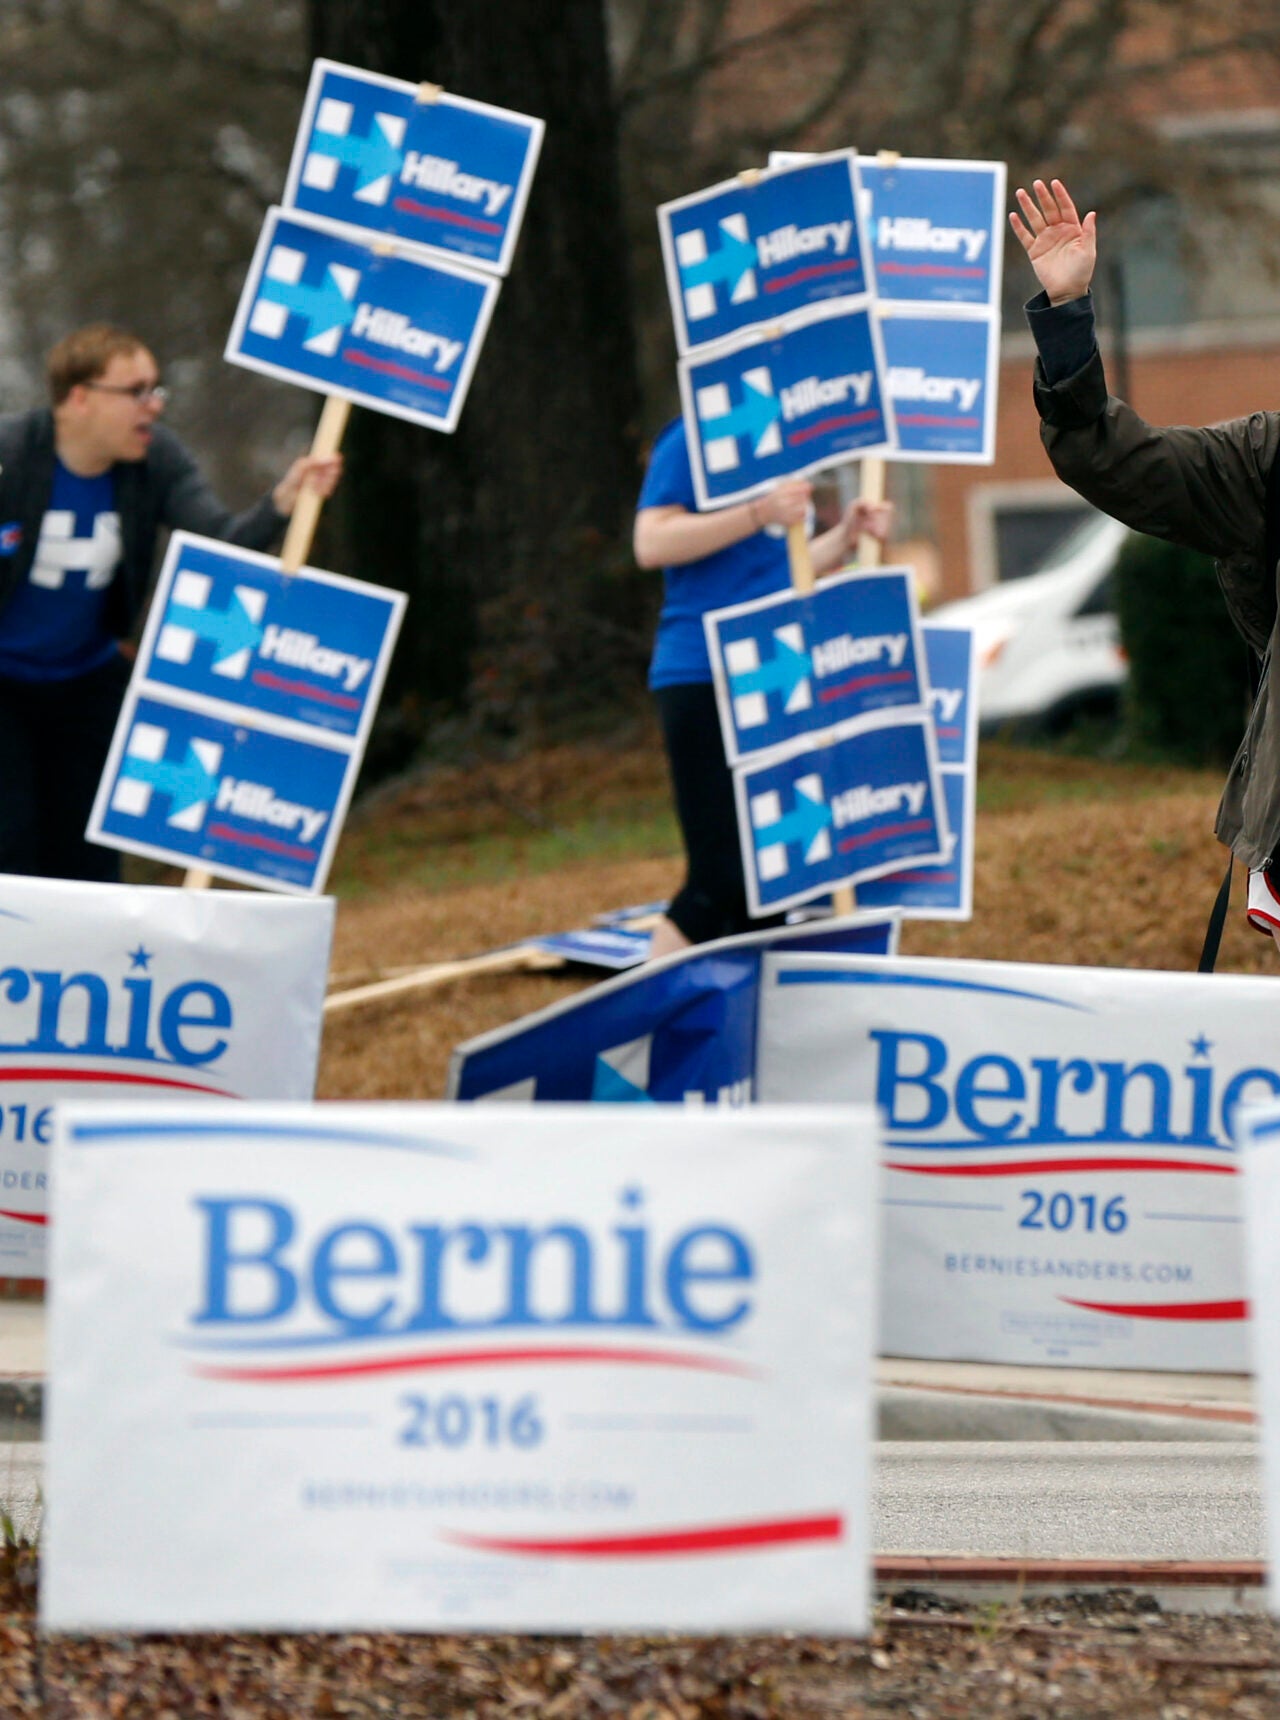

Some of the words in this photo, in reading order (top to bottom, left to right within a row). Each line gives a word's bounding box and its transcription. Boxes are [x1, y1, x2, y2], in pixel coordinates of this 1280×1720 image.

[400, 150, 513, 216] Hillary
[756, 220, 853, 268] Hillary
[877, 216, 987, 261] Hillary
[350, 302, 465, 372] Hillary
[780, 370, 874, 421] Hillary
[258, 624, 373, 692] Hillary
[811, 632, 908, 679] Hillary
[215, 775, 329, 843] Hillary
[831, 781, 927, 828] Hillary
[1018, 1190, 1129, 1234] 2016
[189, 1183, 758, 1334] Bernie
[944, 1252, 1193, 1283] BERNIESANDERS.COM
[396, 1392, 544, 1450] 2016
